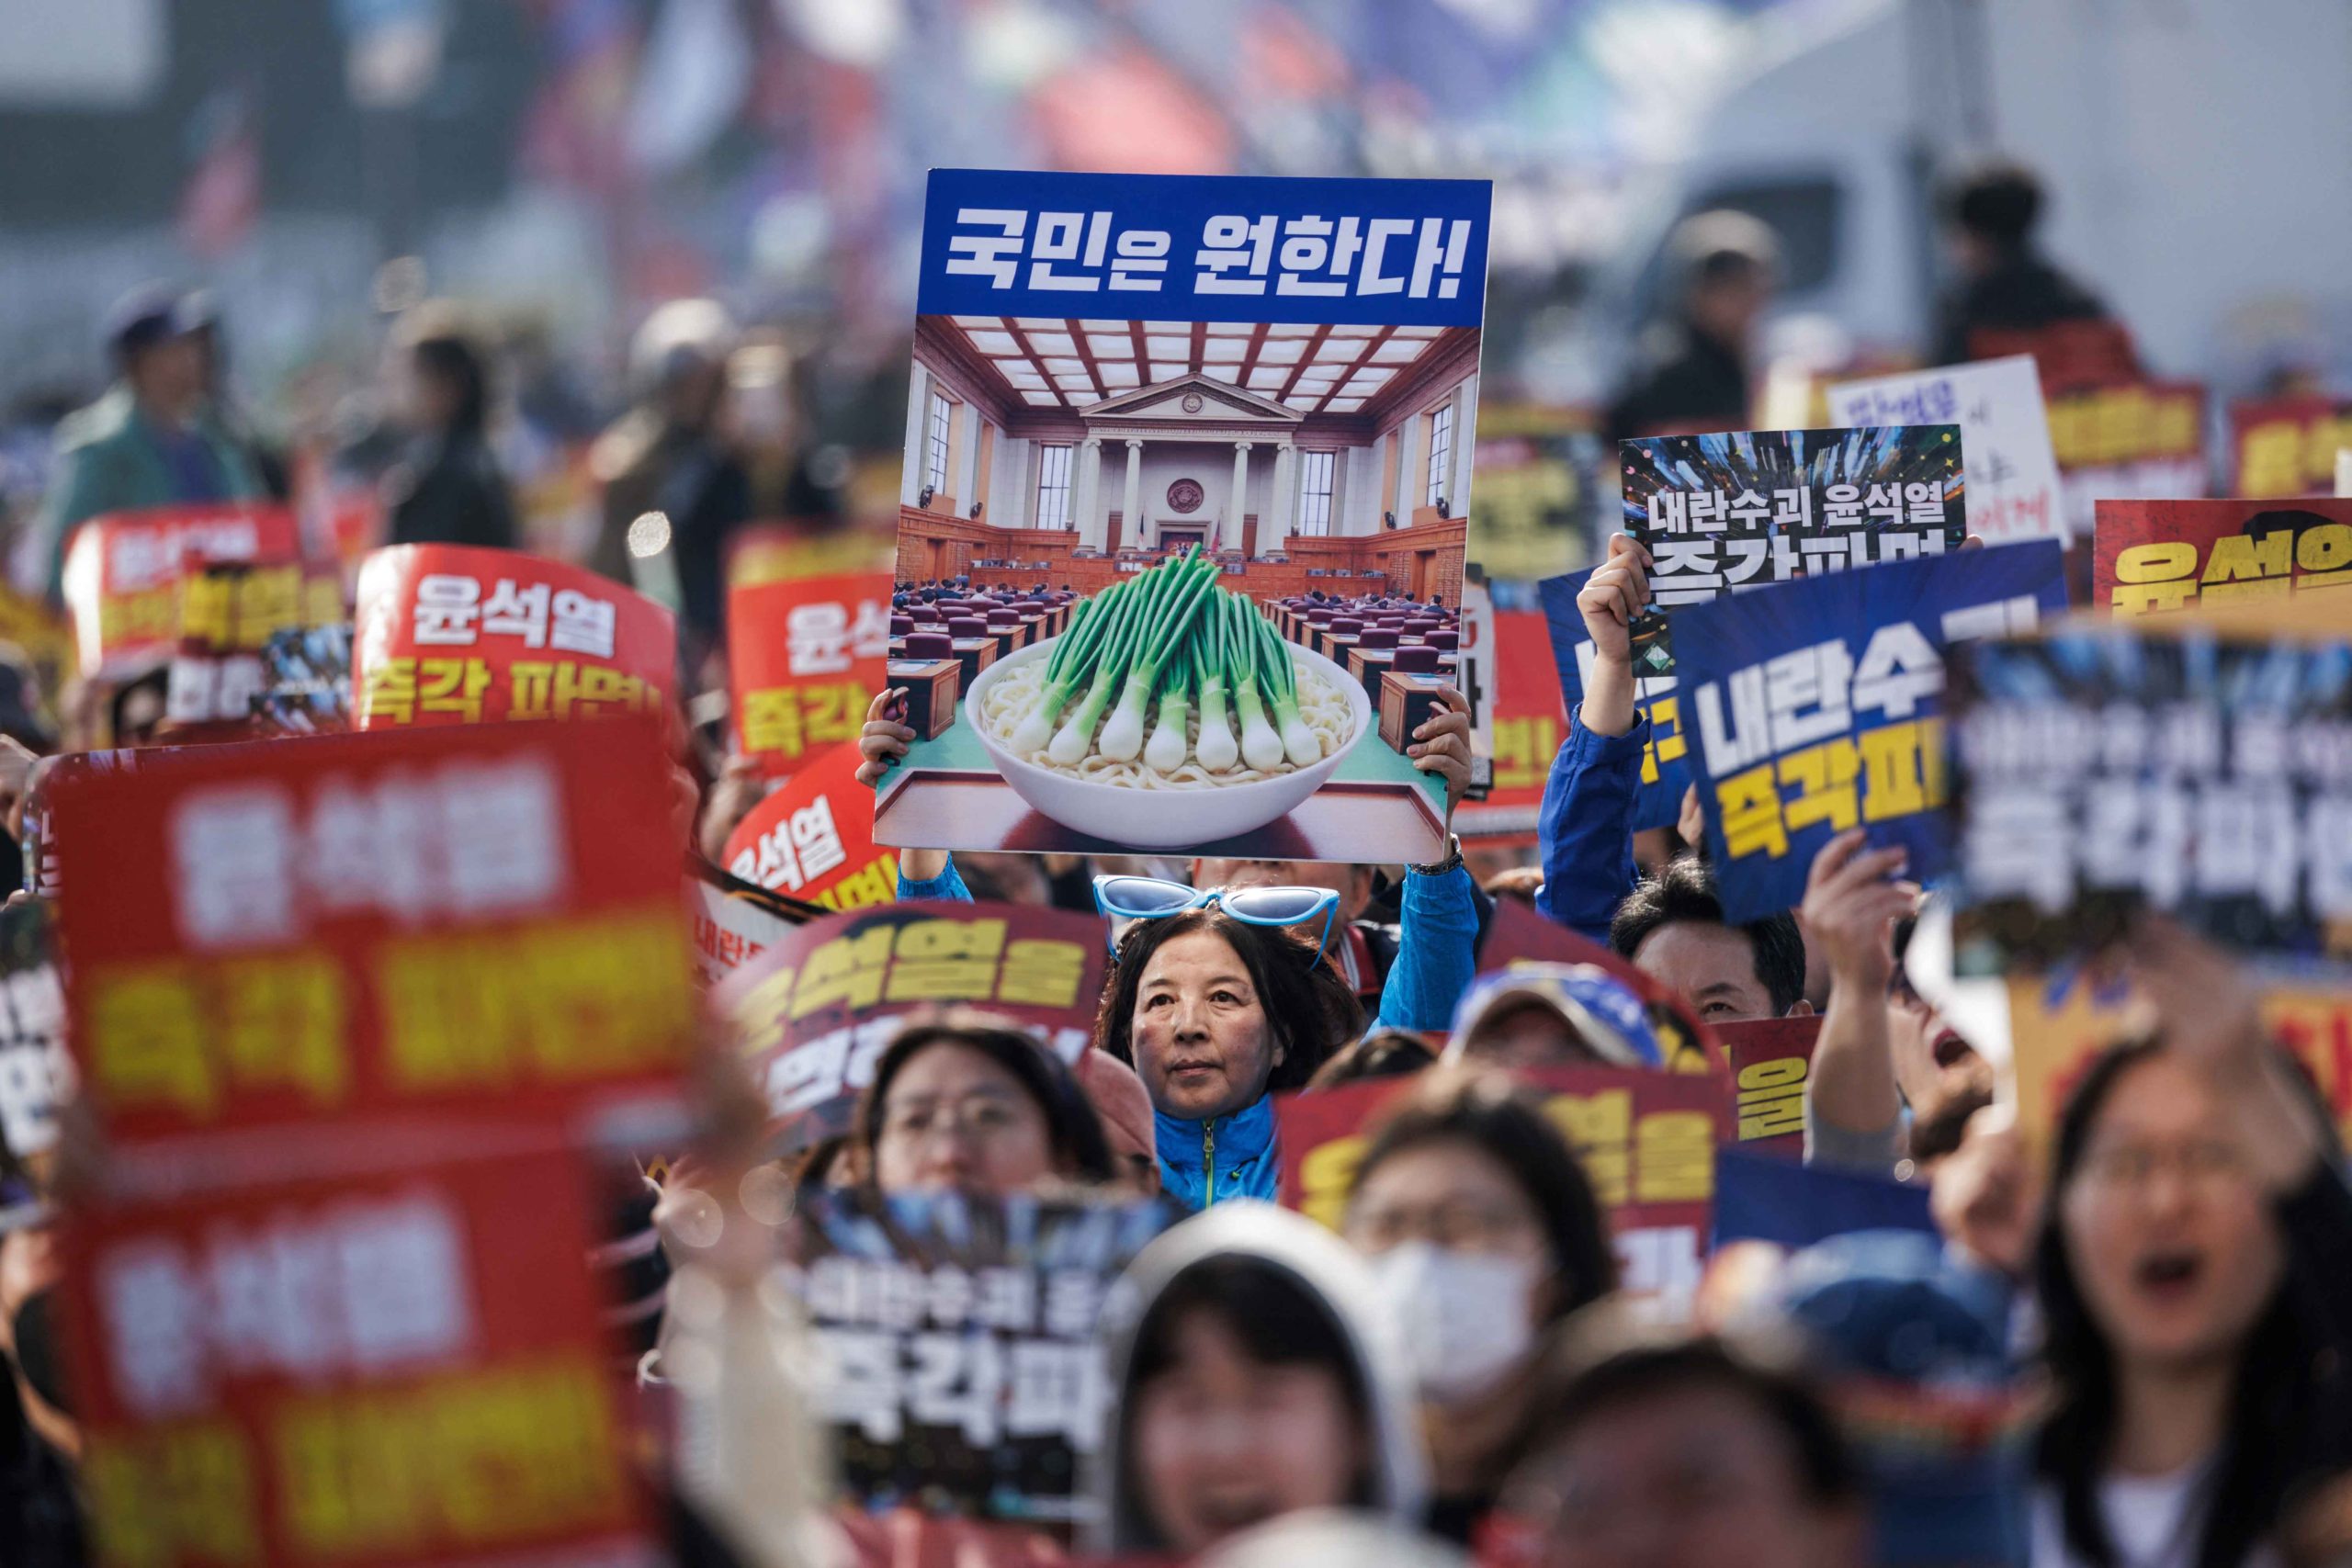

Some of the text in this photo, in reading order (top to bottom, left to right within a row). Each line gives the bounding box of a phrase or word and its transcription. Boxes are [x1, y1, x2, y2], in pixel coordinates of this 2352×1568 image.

[945, 209, 1472, 299] 국민은 원한다!
[1647, 485, 1813, 534] 내란수괴
[1823, 480, 1946, 526] 윤석열
[414, 573, 616, 659] 윤석열
[361, 657, 492, 724] 즉각
[1694, 594, 2039, 779] 내란수
